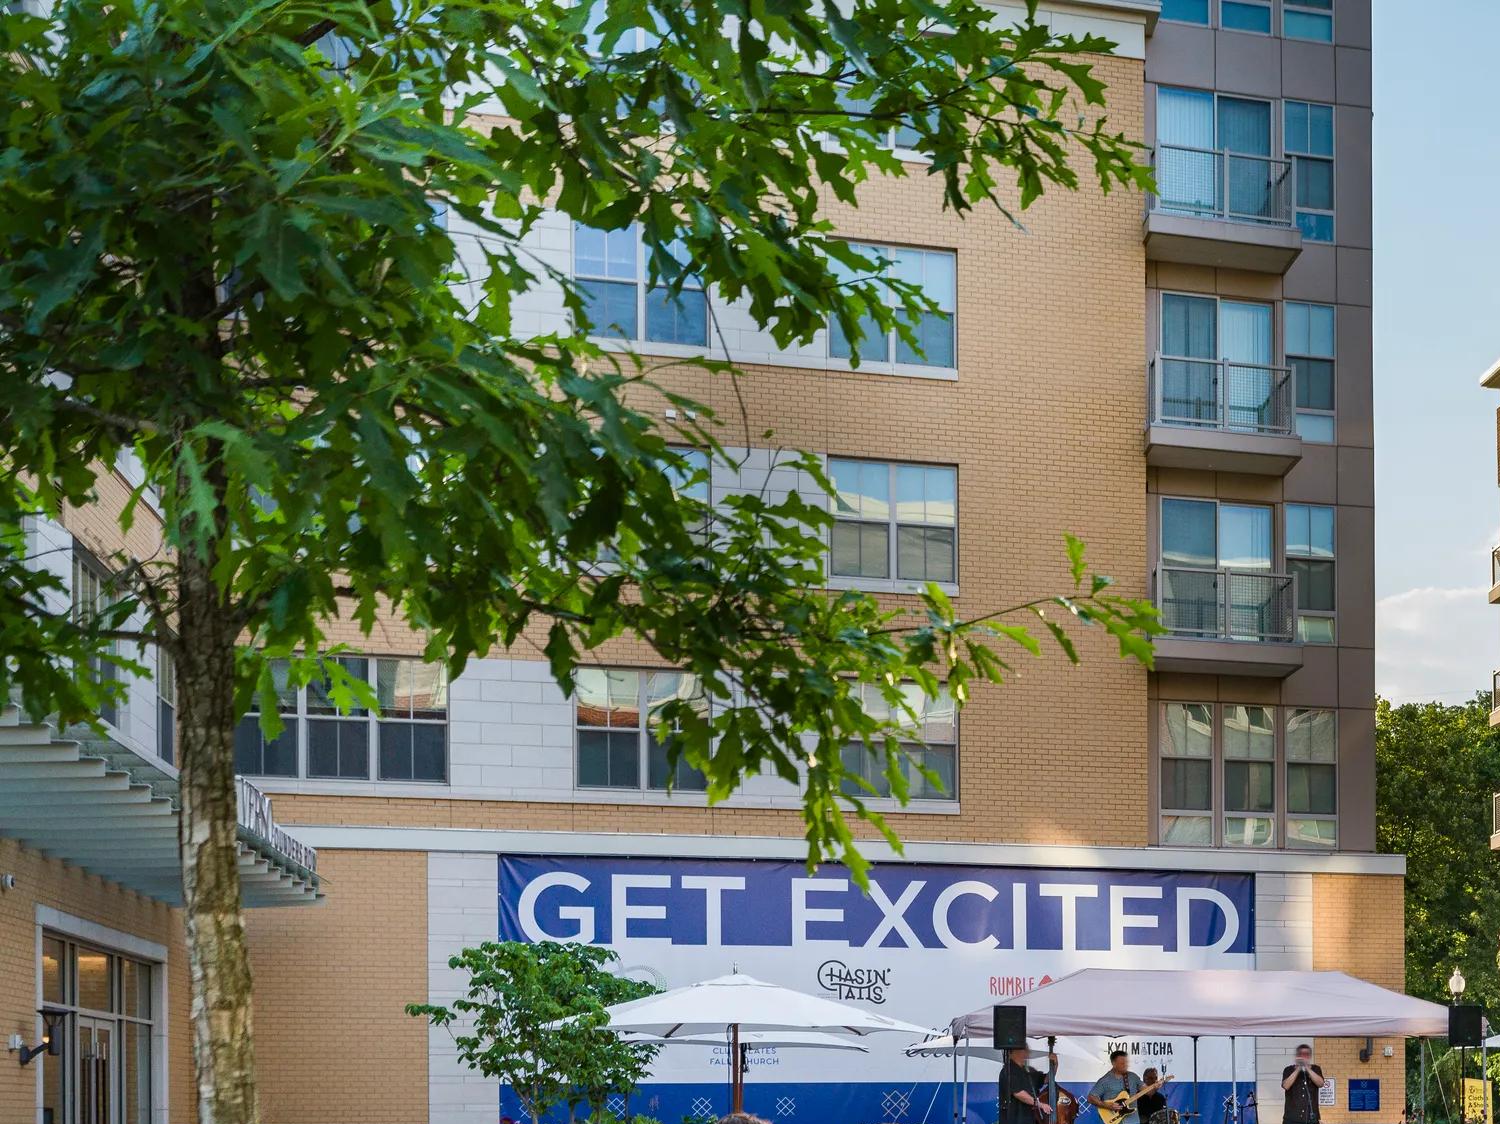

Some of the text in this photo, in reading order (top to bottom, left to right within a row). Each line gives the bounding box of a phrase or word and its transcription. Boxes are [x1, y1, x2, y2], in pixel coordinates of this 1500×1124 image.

[518, 871, 1241, 954] GET EXCITED
[830, 982, 887, 1005] TAILS
[747, 1057, 779, 1065] HURCH
